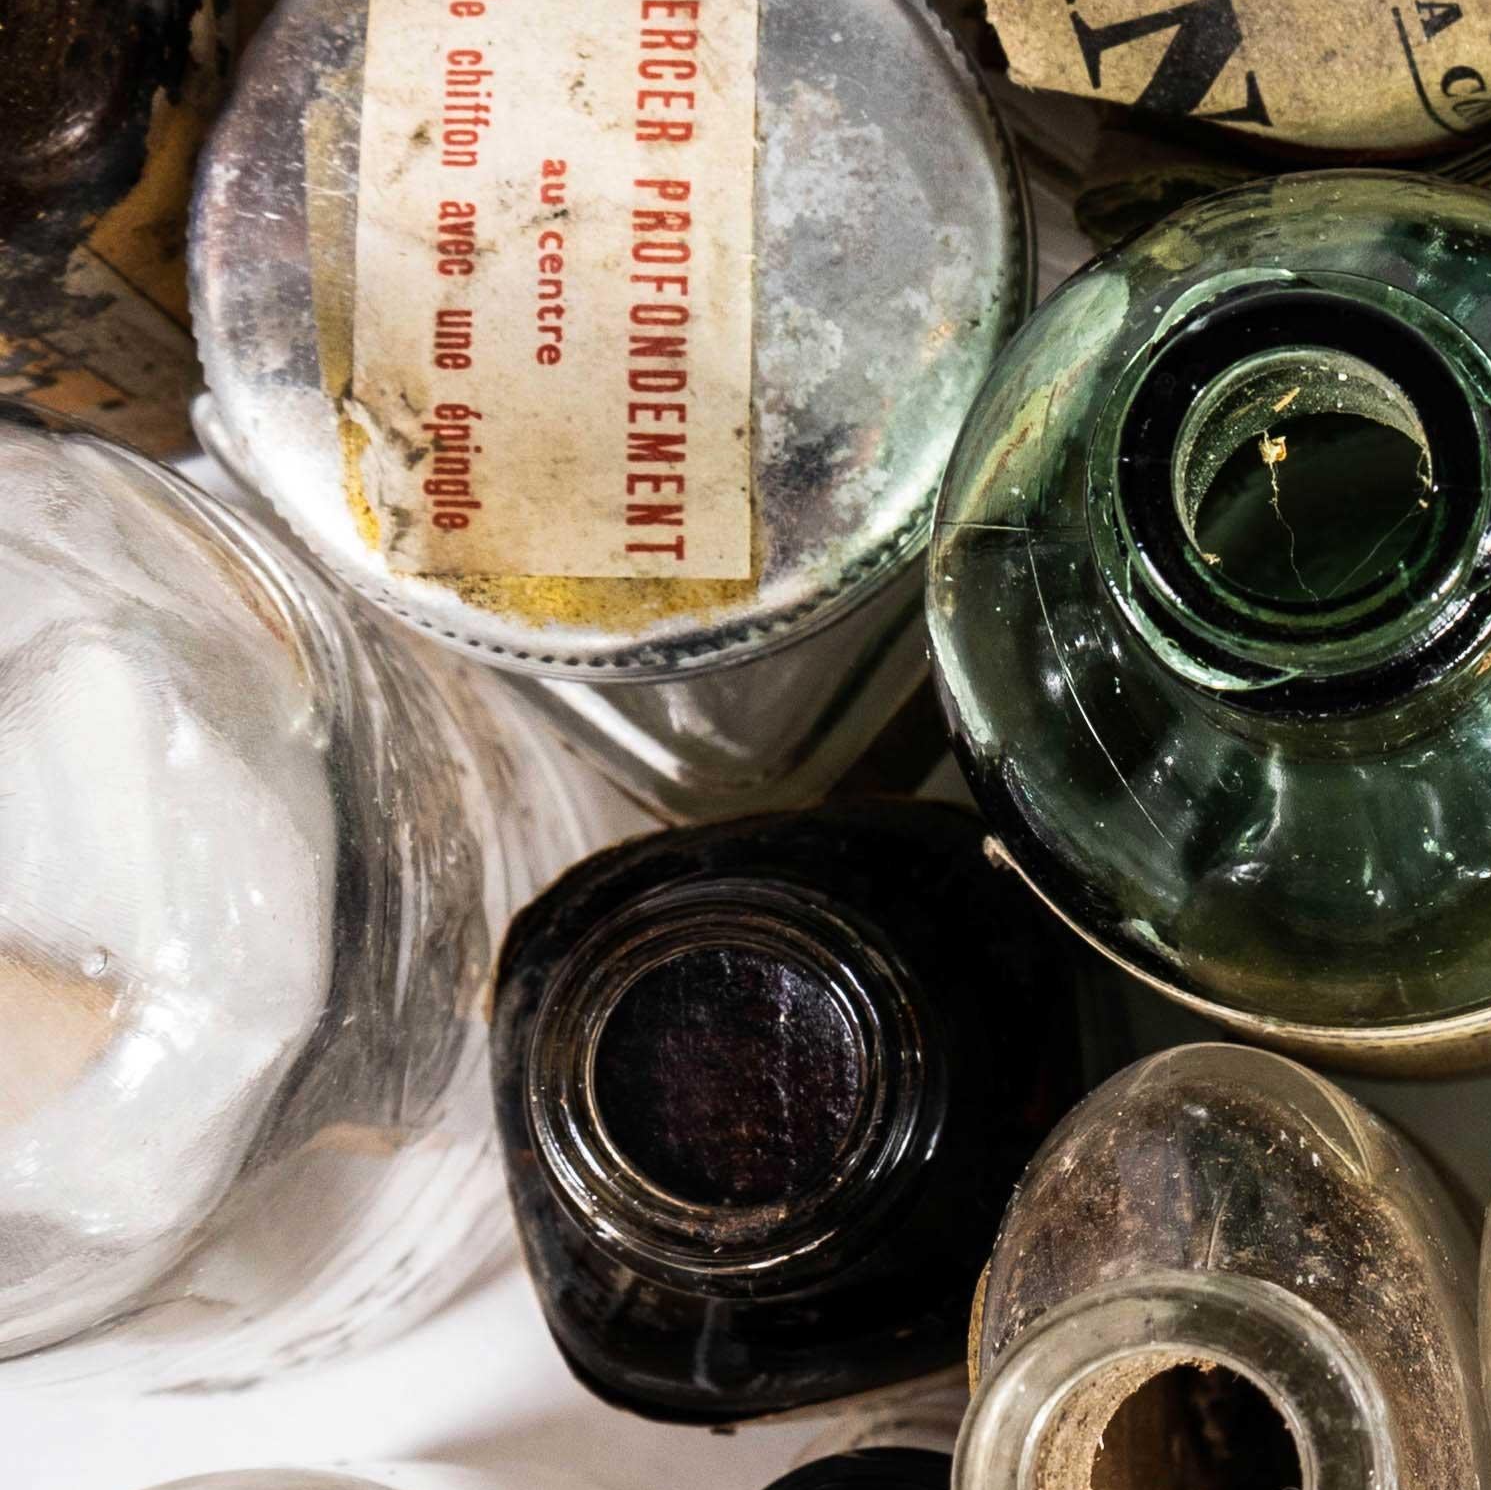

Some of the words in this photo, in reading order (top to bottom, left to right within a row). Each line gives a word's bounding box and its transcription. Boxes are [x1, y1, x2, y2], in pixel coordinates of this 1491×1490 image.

[441, 48, 495, 170] chiffon
[435, 199, 478, 278] avec
[540, 157, 568, 206] au
[433, 308, 474, 372] une
[535, 228, 568, 367] centre
[624, 178, 693, 562] PROFONDEMENT
[421, 401, 484, 533] épingle
